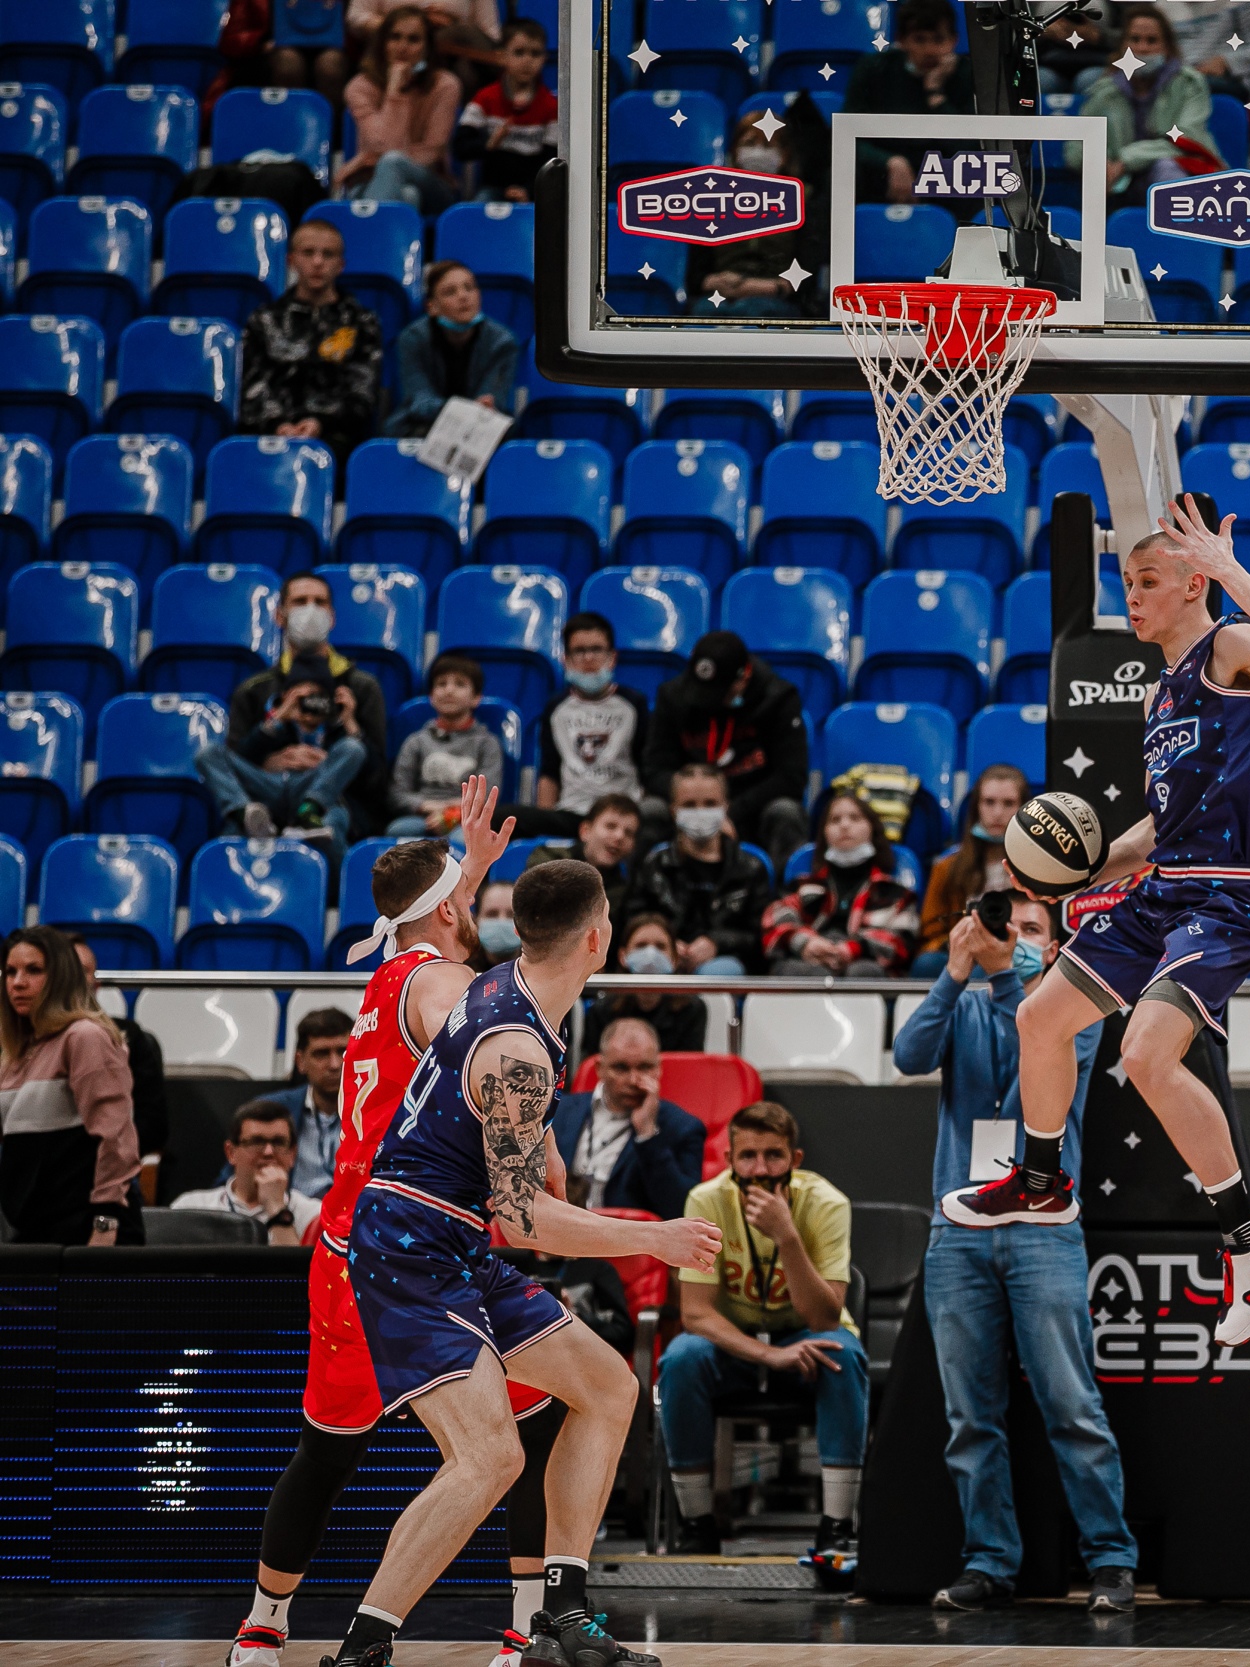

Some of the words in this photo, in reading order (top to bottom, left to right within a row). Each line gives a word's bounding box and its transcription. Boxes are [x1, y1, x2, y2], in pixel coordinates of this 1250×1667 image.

[637, 192, 786, 216] ВОСТОК
[1068, 680, 1153, 707] SPALDI
[1154, 782, 1170, 813] 9
[1022, 799, 1079, 855] SPALDING
[506, 1083, 549, 1098] MAMBA
[519, 1098, 547, 1109] OUT
[517, 1132, 538, 1151] 24
[536, 1165, 547, 1178] 10
[1087, 1254, 1224, 1300] АТЧ
[547, 1568, 563, 1587] 3
